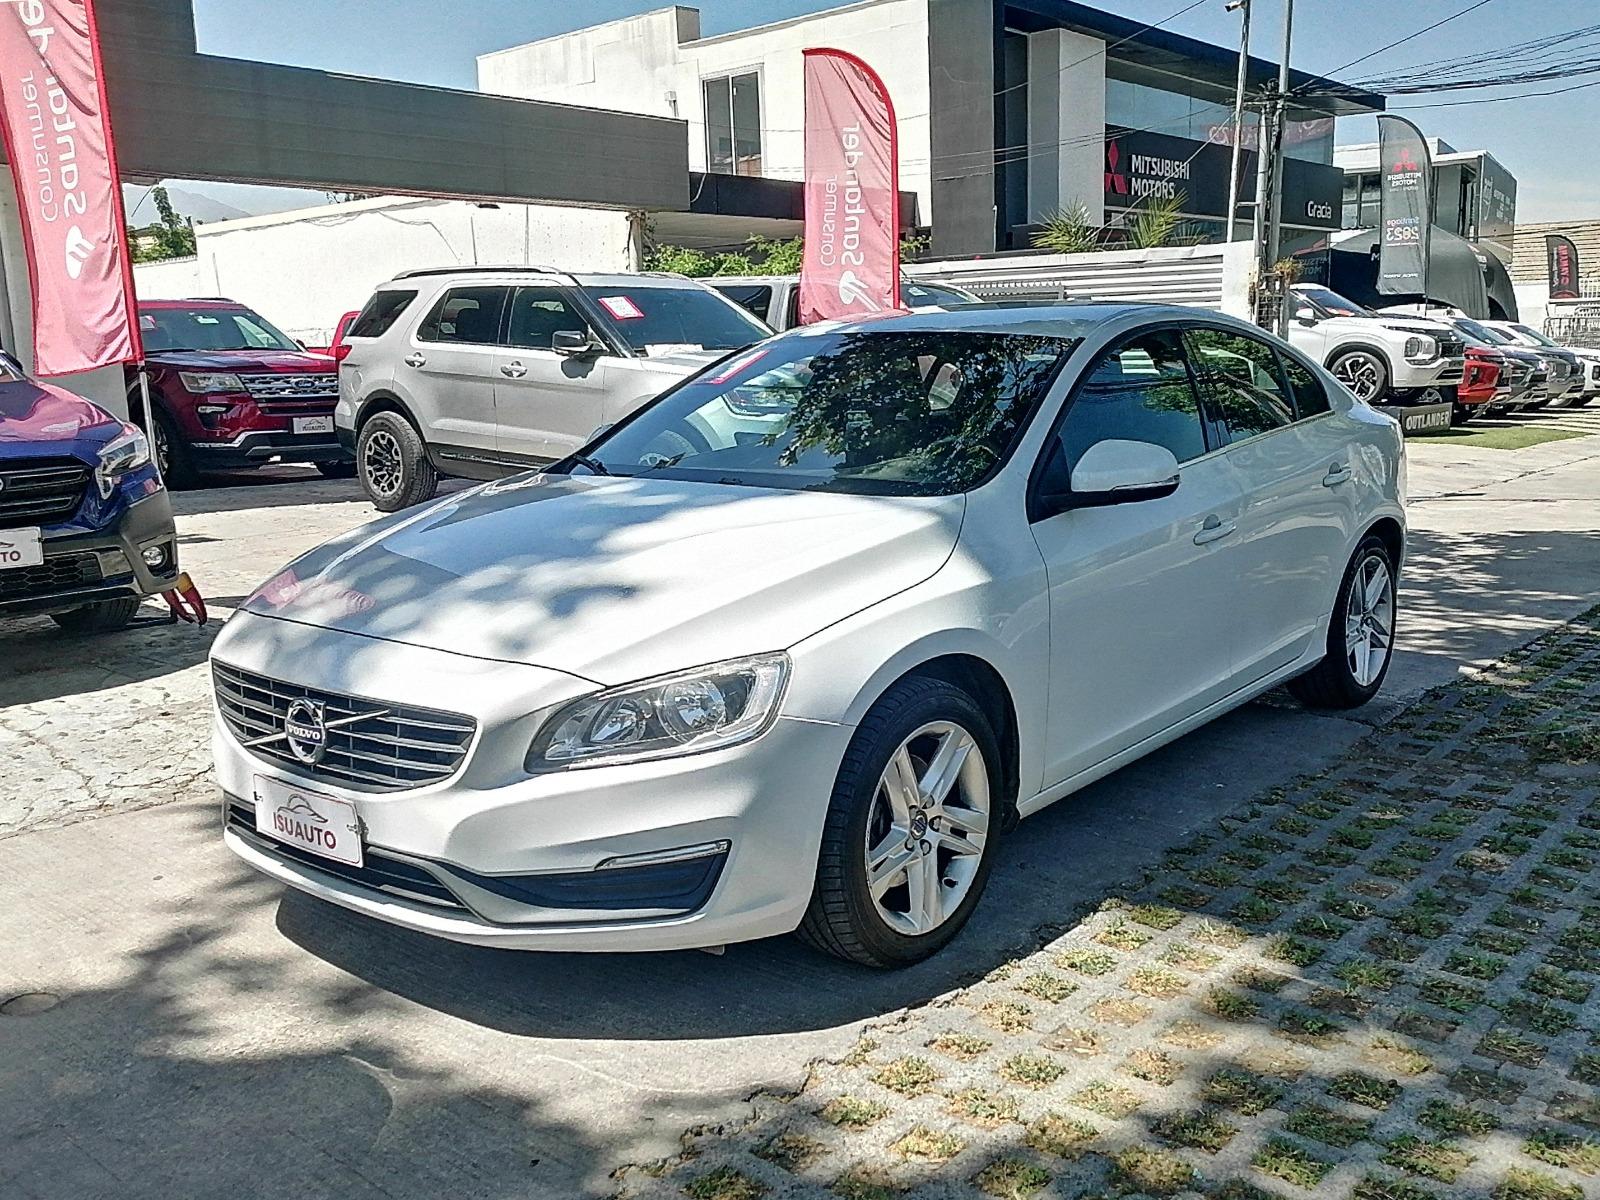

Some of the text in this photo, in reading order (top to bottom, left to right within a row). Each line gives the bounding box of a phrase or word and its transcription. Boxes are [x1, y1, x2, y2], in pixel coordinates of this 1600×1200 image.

[1131, 154, 1190, 180] MITSUBISHI
[1131, 177, 1175, 200] MOTORS
[1307, 200, 1332, 219] Gracia
[1405, 411, 1450, 431] OUTLANDER
[287, 724, 321, 742] VOLVO
[273, 811, 337, 850] ISUAUTO
